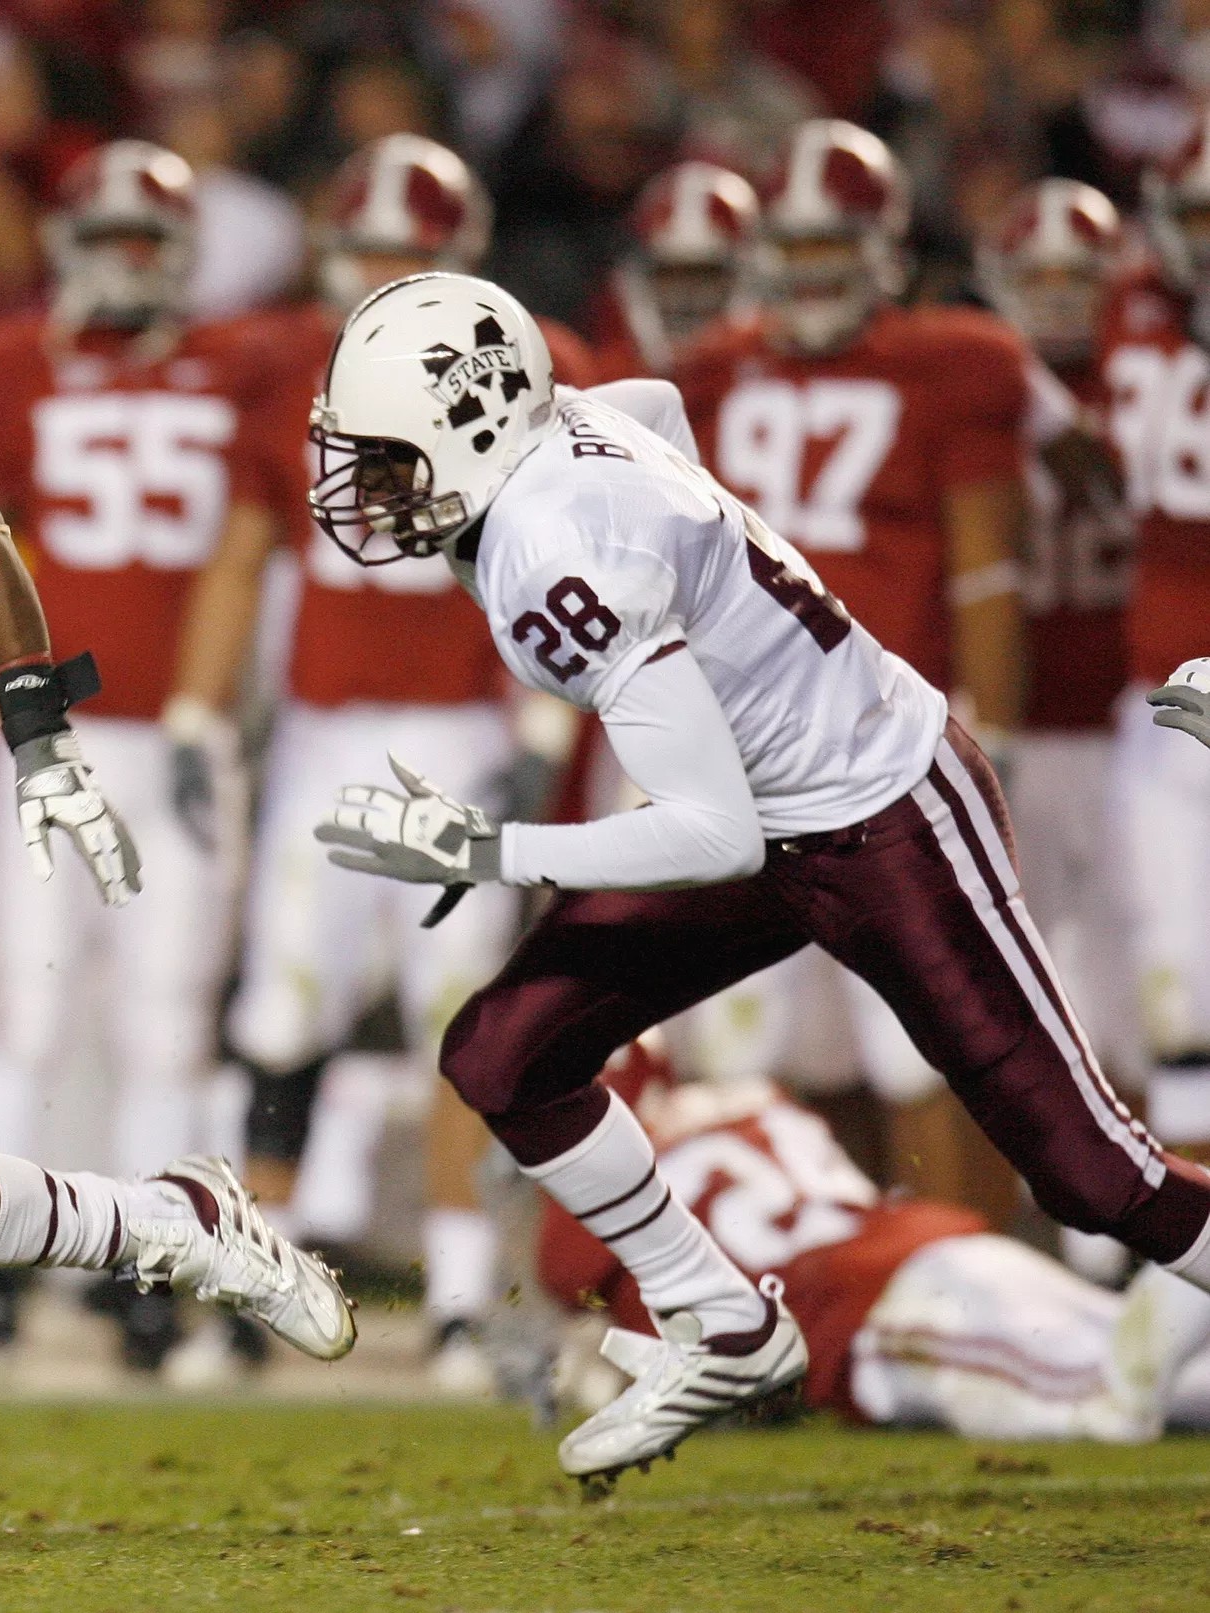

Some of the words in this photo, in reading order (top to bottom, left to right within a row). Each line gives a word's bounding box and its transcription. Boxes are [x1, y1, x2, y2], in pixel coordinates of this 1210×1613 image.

[448, 349, 510, 395] STATE
[32, 394, 236, 570] 55
[512, 576, 621, 685] 28
